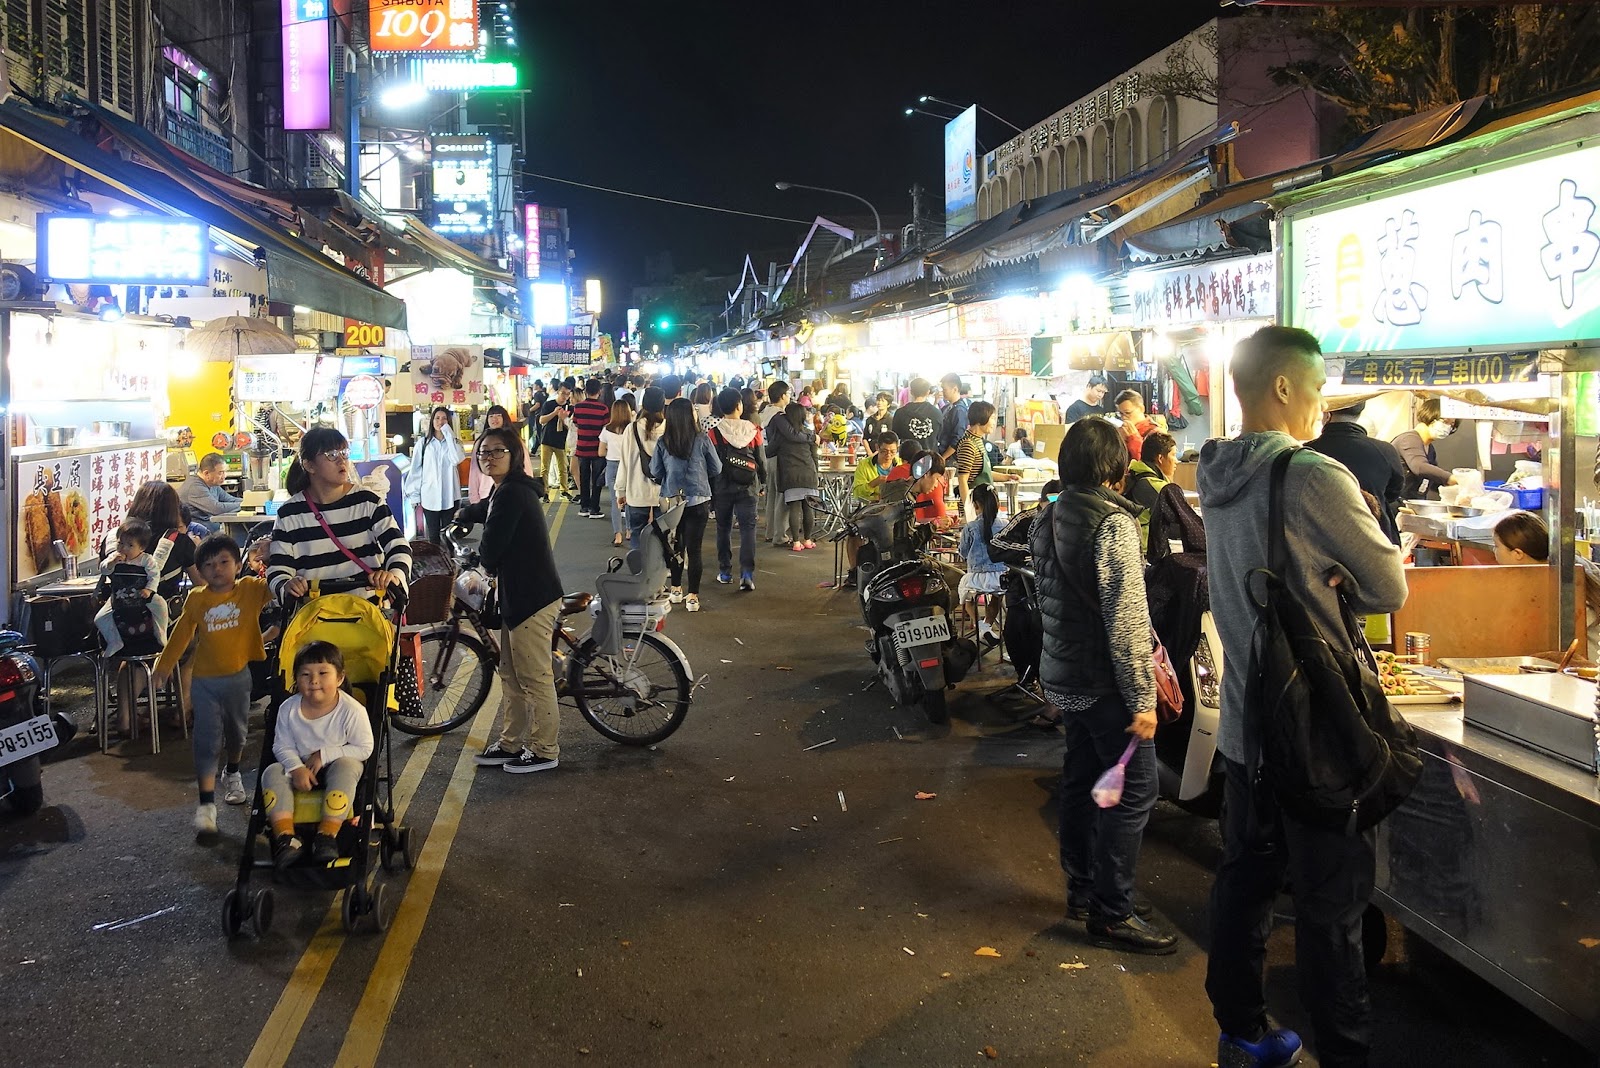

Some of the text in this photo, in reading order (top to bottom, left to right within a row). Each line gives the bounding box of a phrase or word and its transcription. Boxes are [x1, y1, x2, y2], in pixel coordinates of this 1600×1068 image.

[376, 9, 446, 47] 109
[347, 326, 383, 345] 200
[34, 458, 81, 495] 臭豆腐
[207, 619, 239, 632] Roots
